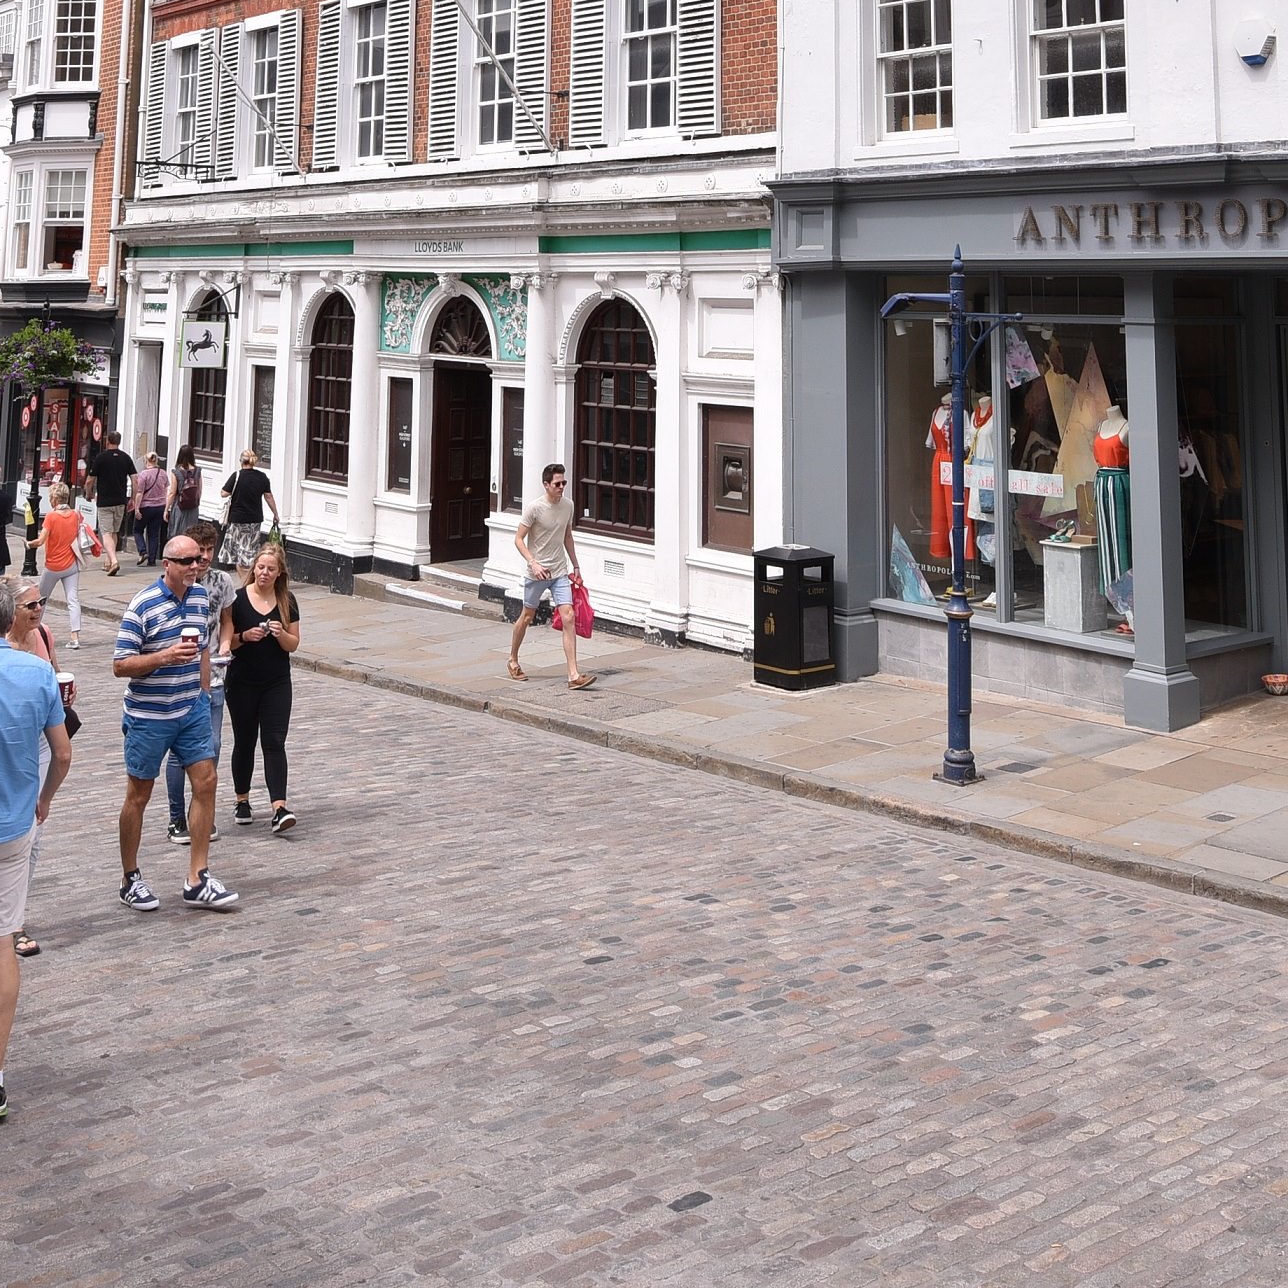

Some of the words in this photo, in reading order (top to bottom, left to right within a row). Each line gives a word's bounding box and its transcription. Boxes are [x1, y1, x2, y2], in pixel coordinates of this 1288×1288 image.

[415, 242, 442, 252] LLOYDS
[443, 241, 464, 252] BANK
[1036, 482, 1063, 496] sale
